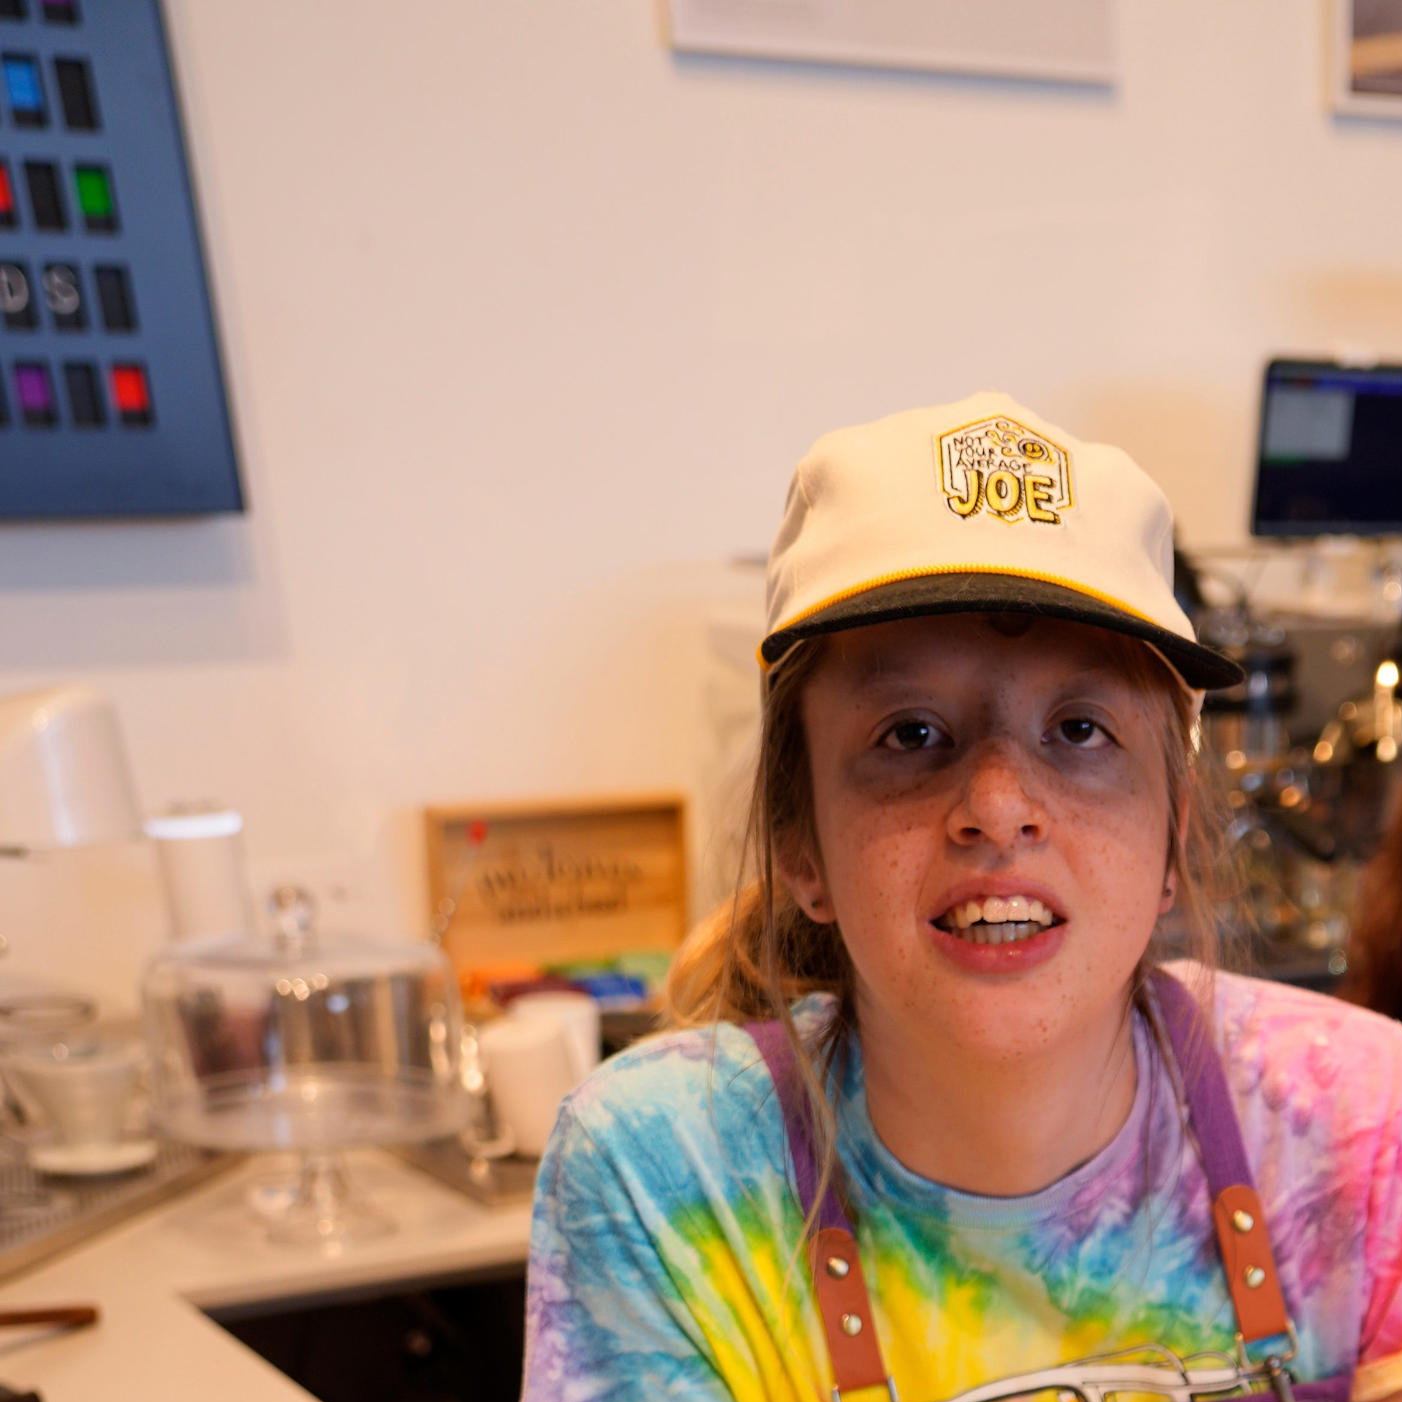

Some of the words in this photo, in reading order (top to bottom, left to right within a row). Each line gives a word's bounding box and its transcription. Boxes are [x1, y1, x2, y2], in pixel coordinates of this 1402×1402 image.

[953, 436, 986, 447] NOT
[955, 446, 997, 460] YOUR
[956, 459, 1033, 475] AVERAGE
[947, 469, 1061, 524] JOE
